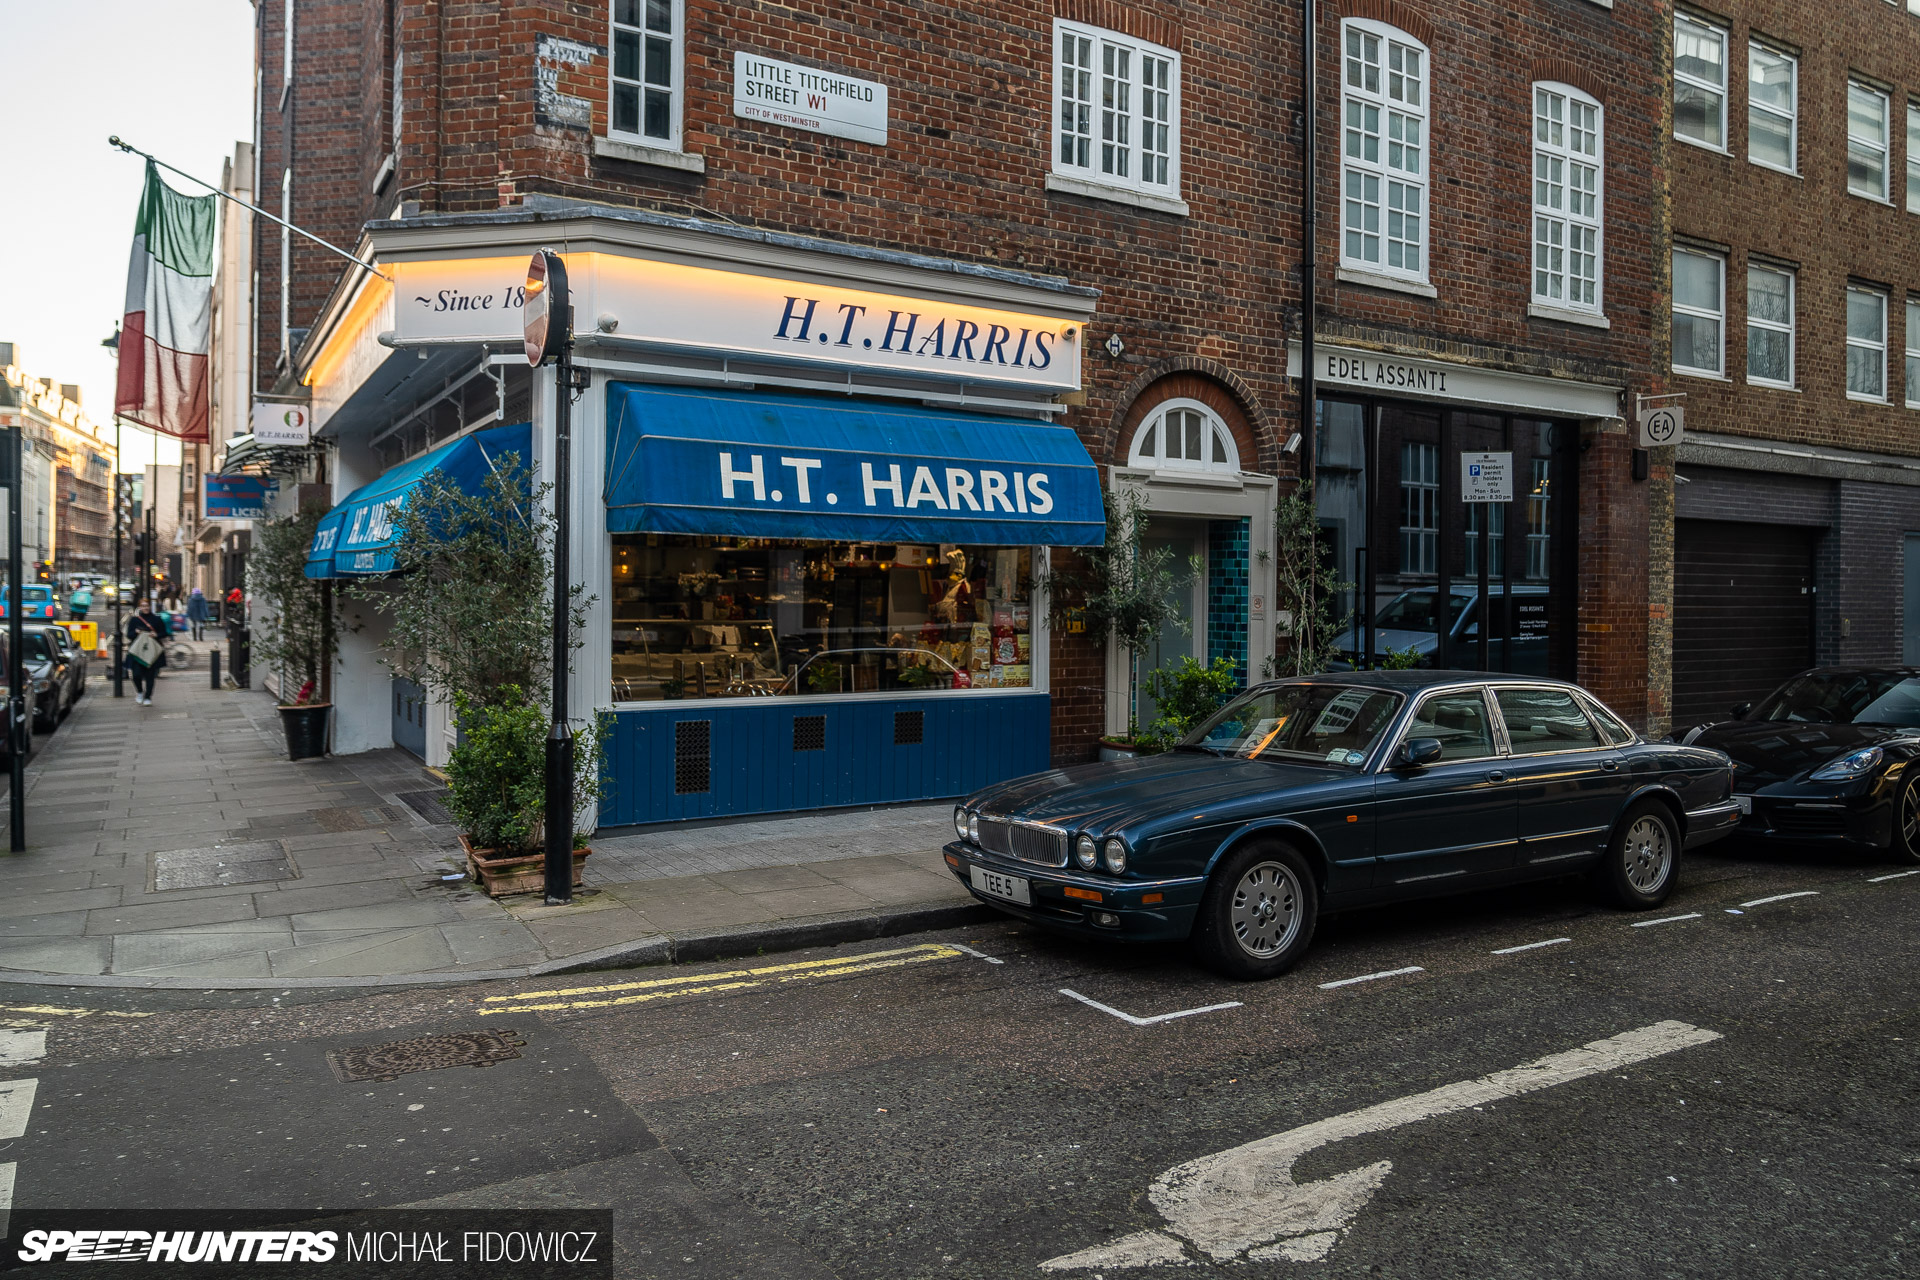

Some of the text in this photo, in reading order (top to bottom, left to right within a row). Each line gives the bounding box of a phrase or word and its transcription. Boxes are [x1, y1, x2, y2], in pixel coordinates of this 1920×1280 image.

[746, 60, 873, 102] LITTLE TITCHFIELD
[745, 80, 826, 111] STREET W1
[745, 106, 820, 129] CITY OF WESTMINSTER
[501, 286, 526, 309] 18
[1110, 338, 1120, 352] H
[1328, 356, 1446, 392] EDEL ASSANTI
[1653, 419, 1670, 434] EA
[719, 452, 1054, 514] H.T. HARRIS
[232, 507, 264, 517] LICEN
[983, 873, 1013, 896] TEE 5
